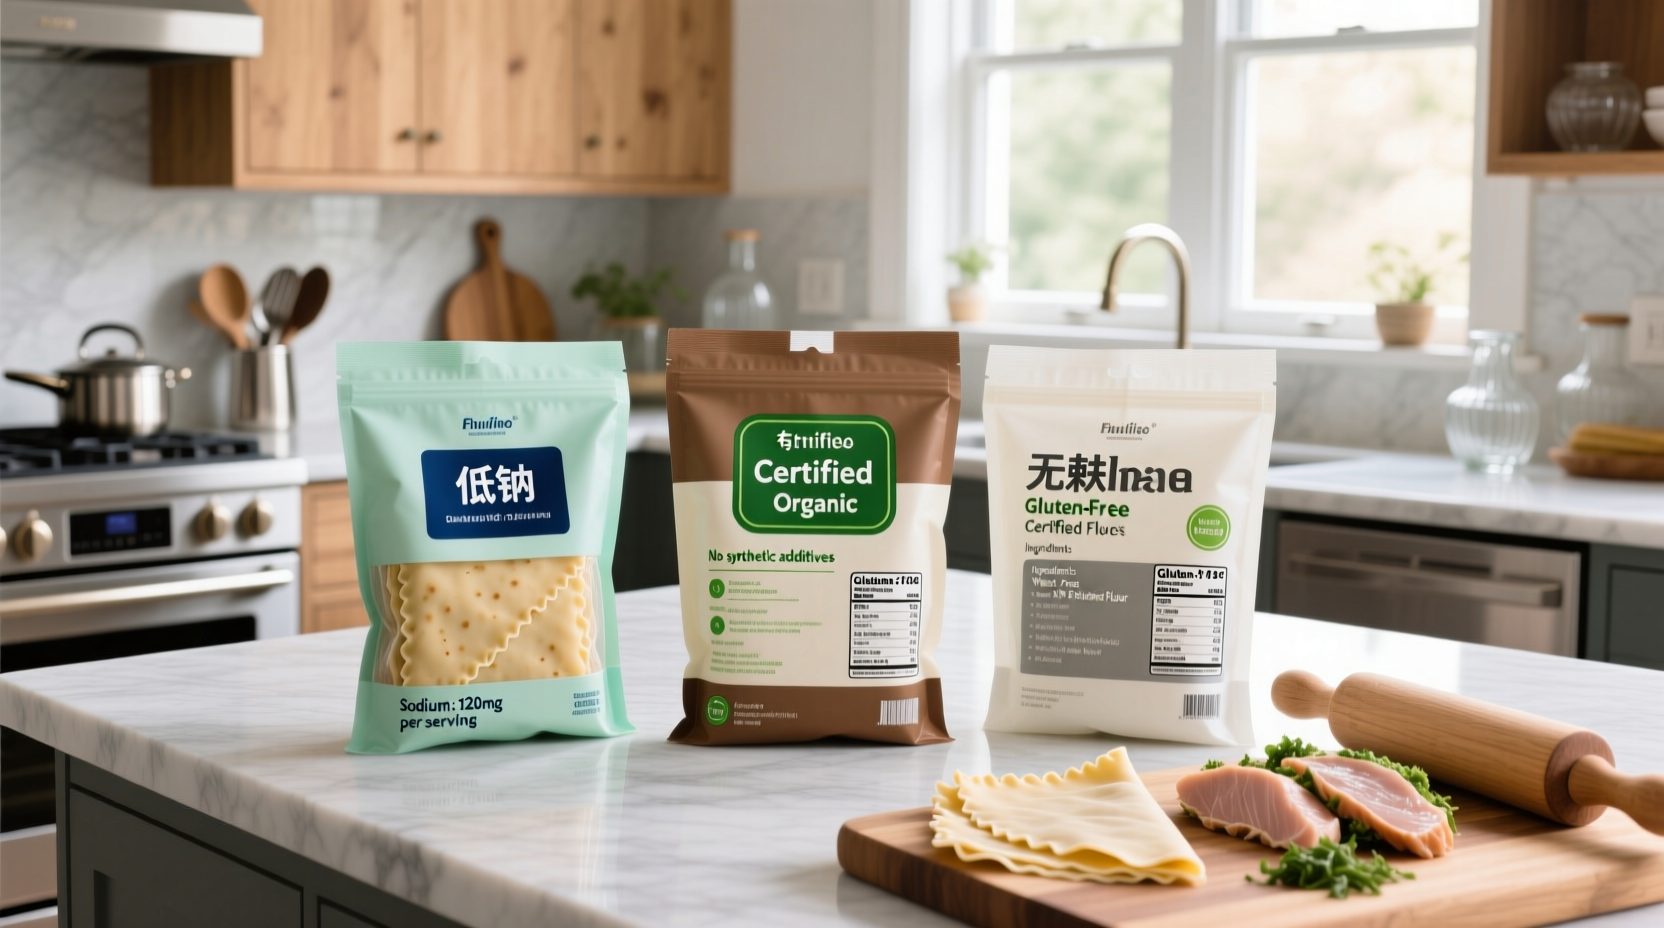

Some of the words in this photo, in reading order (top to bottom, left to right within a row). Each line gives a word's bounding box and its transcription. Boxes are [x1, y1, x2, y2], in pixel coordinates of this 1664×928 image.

[754, 459, 873, 484] Certified
[455, 463, 535, 505] 低钠
[773, 492, 858, 519] Organic
[1025, 497, 1130, 517] Gluten-Free
[708, 549, 724, 562] No
[779, 549, 836, 563] additives
[458, 696, 503, 713] 120mg
[400, 717, 423, 732] per
